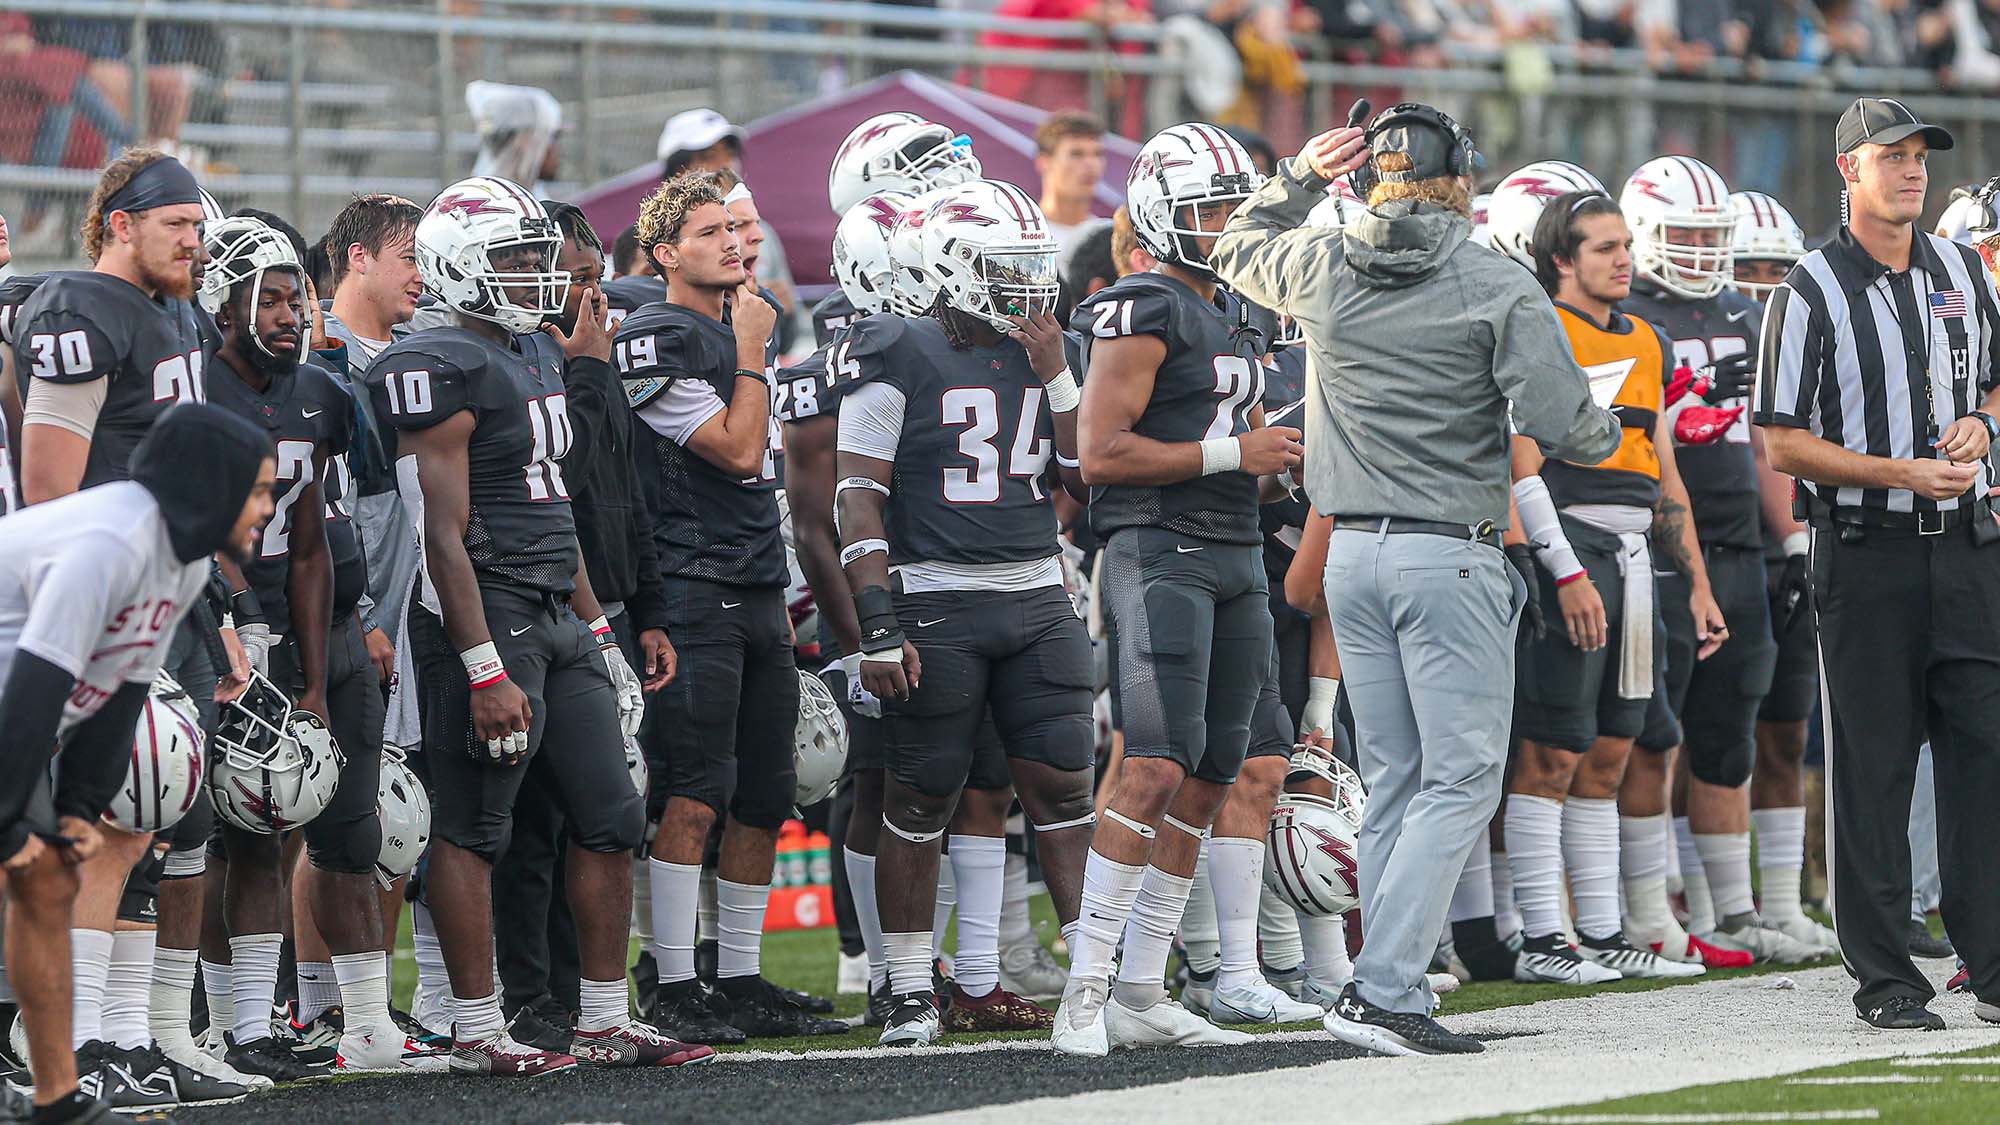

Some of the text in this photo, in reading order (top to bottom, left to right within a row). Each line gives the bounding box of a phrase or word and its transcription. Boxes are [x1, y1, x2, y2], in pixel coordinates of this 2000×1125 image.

[1091, 299, 1136, 338] 21
[30, 329, 94, 378] 30
[616, 334, 658, 373] 19
[825, 340, 861, 389] 34
[1951, 348, 1968, 380] H
[384, 369, 434, 415] 10
[774, 376, 819, 421] 28
[523, 392, 574, 501] 10
[940, 386, 1054, 503] 34
[1271, 807, 1295, 816] Ridde
